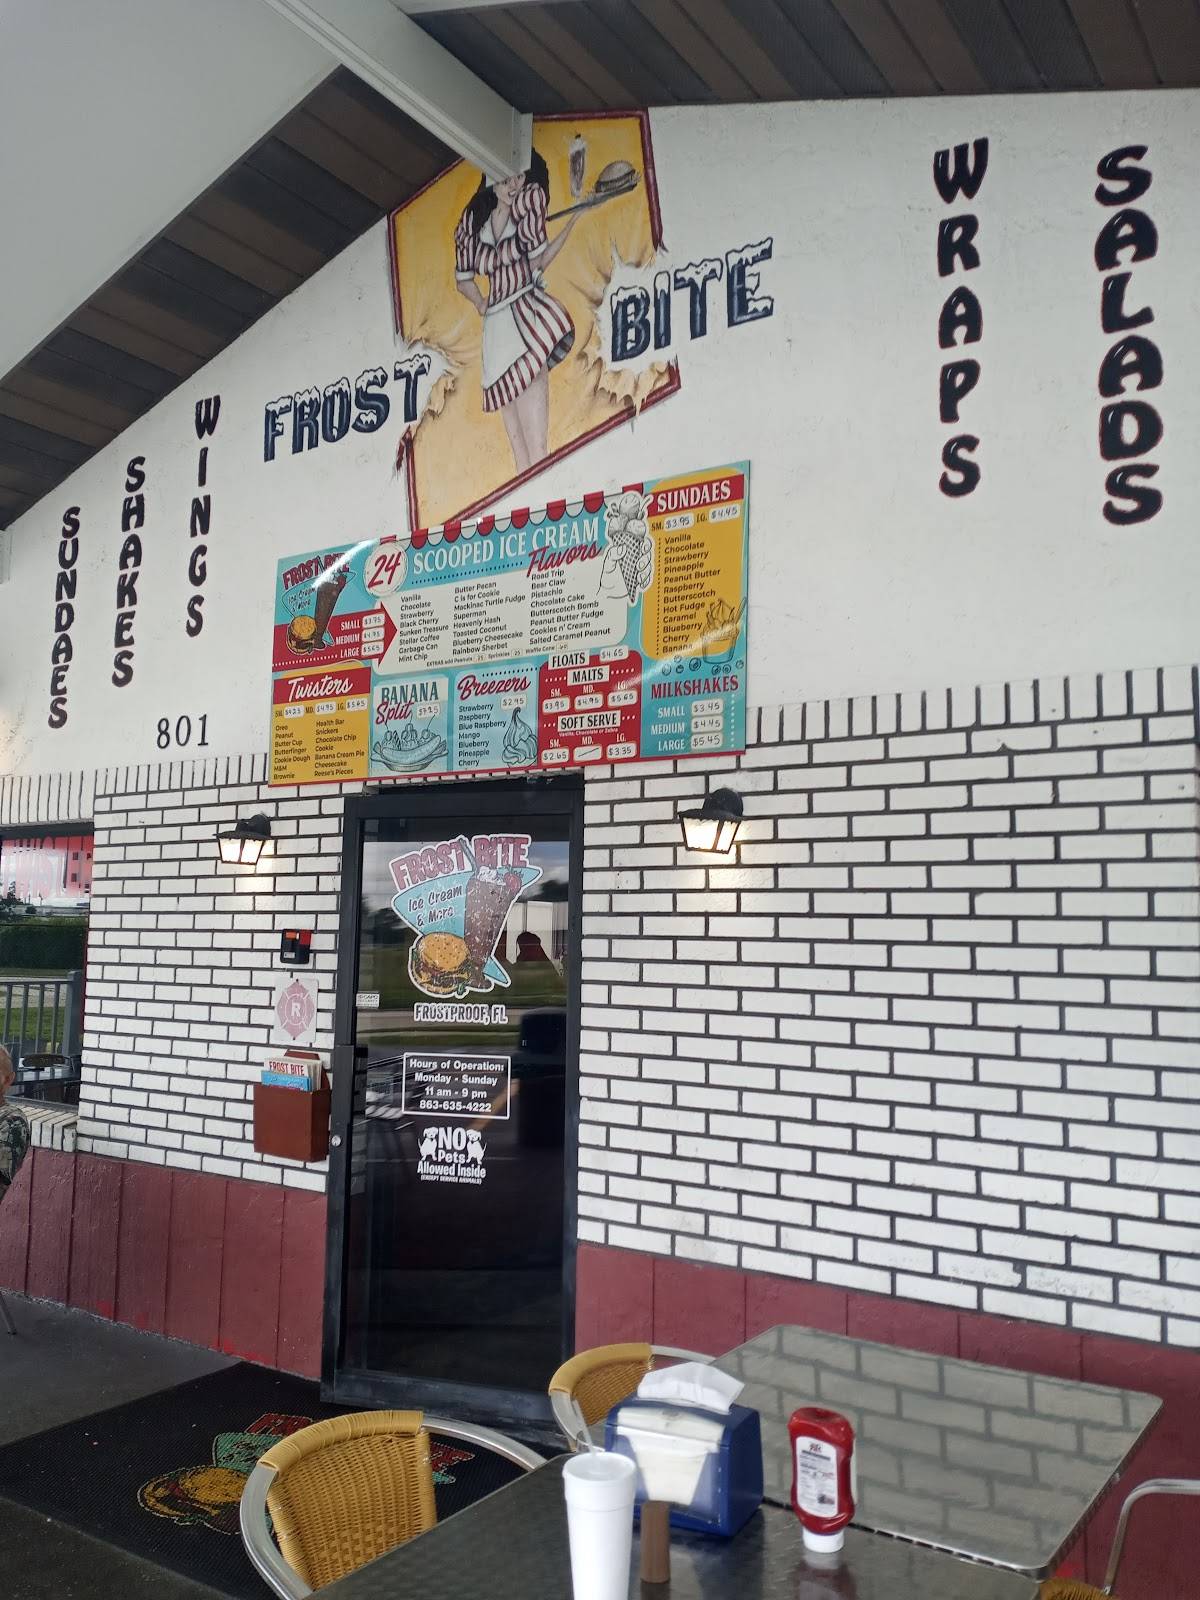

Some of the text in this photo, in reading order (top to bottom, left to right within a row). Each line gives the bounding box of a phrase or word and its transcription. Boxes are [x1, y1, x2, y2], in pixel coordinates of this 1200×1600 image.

[933, 139, 989, 497] WRAPS
[1095, 143, 1162, 527] SALADS
[262, 237, 775, 461] FROST BITE
[658, 480, 731, 512] SUNDAES
[187, 396, 219, 638] WINGS
[665, 534, 691, 544] Vanilla
[368, 552, 401, 588] 24
[413, 544, 494, 574] SCOOPED
[500, 530, 526, 560] ICE
[533, 517, 599, 550] CREAM
[665, 542, 704, 554] Chocolate
[526, 541, 604, 577] Flavors
[664, 552, 708, 565] Strawberry
[111, 456, 146, 686] SHAKES
[664, 561, 704, 574] Pineapple
[532, 569, 564, 581] Road Trip
[664, 570, 720, 583] Peanut Butter
[477, 582, 496, 590] Pecan
[532, 578, 565, 589] Bear Claw
[664, 582, 704, 594] Raspberry
[401, 593, 421, 603] Vanilla
[478, 590, 500, 599] Cookie
[531, 589, 562, 599] Pistachio
[664, 591, 715, 604] Butterscotch
[401, 602, 431, 611] Chocolate
[454, 602, 483, 611] Mackinac
[505, 594, 525, 604] Fudge
[531, 594, 585, 608] Chocolate Cake
[530, 601, 599, 618] Butterscotch Bomb
[664, 602, 705, 614] Hot Fudge
[50, 507, 80, 729] SUNDAES
[400, 610, 434, 620] Strawberry
[418, 617, 439, 626] Cherry
[454, 610, 486, 620] Superman
[530, 610, 603, 626] Peanut Butter Fudge
[663, 613, 696, 623] Caramel
[341, 620, 360, 630] SMALL
[454, 616, 500, 628] Heavenly Hash
[530, 626, 557, 635] Cookies
[567, 621, 590, 630] Cream
[663, 623, 702, 634] Blueberry
[400, 625, 448, 637] Sunken Treasure
[453, 625, 507, 637] Toasted Coconut
[530, 628, 610, 644] Salted Caramel Peanut
[335, 634, 360, 645] MEDIUM
[420, 634, 439, 643] Coffee
[453, 632, 523, 647] Blueberry Cheesecake
[663, 635, 689, 644] Cherry
[341, 647, 360, 658] LARGE
[399, 645, 425, 653] Garbage
[453, 643, 507, 655] Rainbow Sherbet
[663, 644, 693, 653] Banana
[413, 652, 428, 661] Chip
[552, 653, 585, 667] FLOATS
[572, 668, 604, 682] MALTS
[288, 675, 353, 702] Twisters
[382, 681, 439, 705] BANANA
[458, 674, 531, 700] Breezers
[651, 675, 739, 699] MILKSHAKES
[376, 701, 414, 724] Split
[459, 704, 494, 712] Strawberry
[658, 703, 720, 718] SMALL $3.45
[459, 713, 490, 721] Raspberry
[561, 713, 617, 729] SOFT SERVE
[474, 720, 506, 729] Raspberry
[651, 723, 685, 734] MEDIUM
[156, 714, 209, 750] 801
[459, 740, 489, 748] Blueberry
[659, 736, 720, 750] LARGE $5.45
[608, 747, 632, 755] $3.35
[391, 837, 529, 890] FROST BITE
[408, 886, 462, 912] Ice Cream
[417, 907, 454, 926] & More
[292, 1003, 300, 1017] R
[414, 1004, 508, 1025] FROSTPROOF, FL
[269, 1062, 304, 1076] FROST BITE
[409, 1059, 504, 1073] Hours of Operation:
[414, 1073, 451, 1085] Monday
[462, 1075, 498, 1087] Sunday
[425, 1087, 433, 1096] 11
[437, 1089, 451, 1097] am
[461, 1089, 468, 1098] 9
[473, 1090, 487, 1100] pm
[419, 1100, 492, 1112] 863-635-4222
[438, 1127, 467, 1150] NO
[438, 1150, 466, 1163] Pets
[418, 1162, 486, 1178] Allowed Inside
